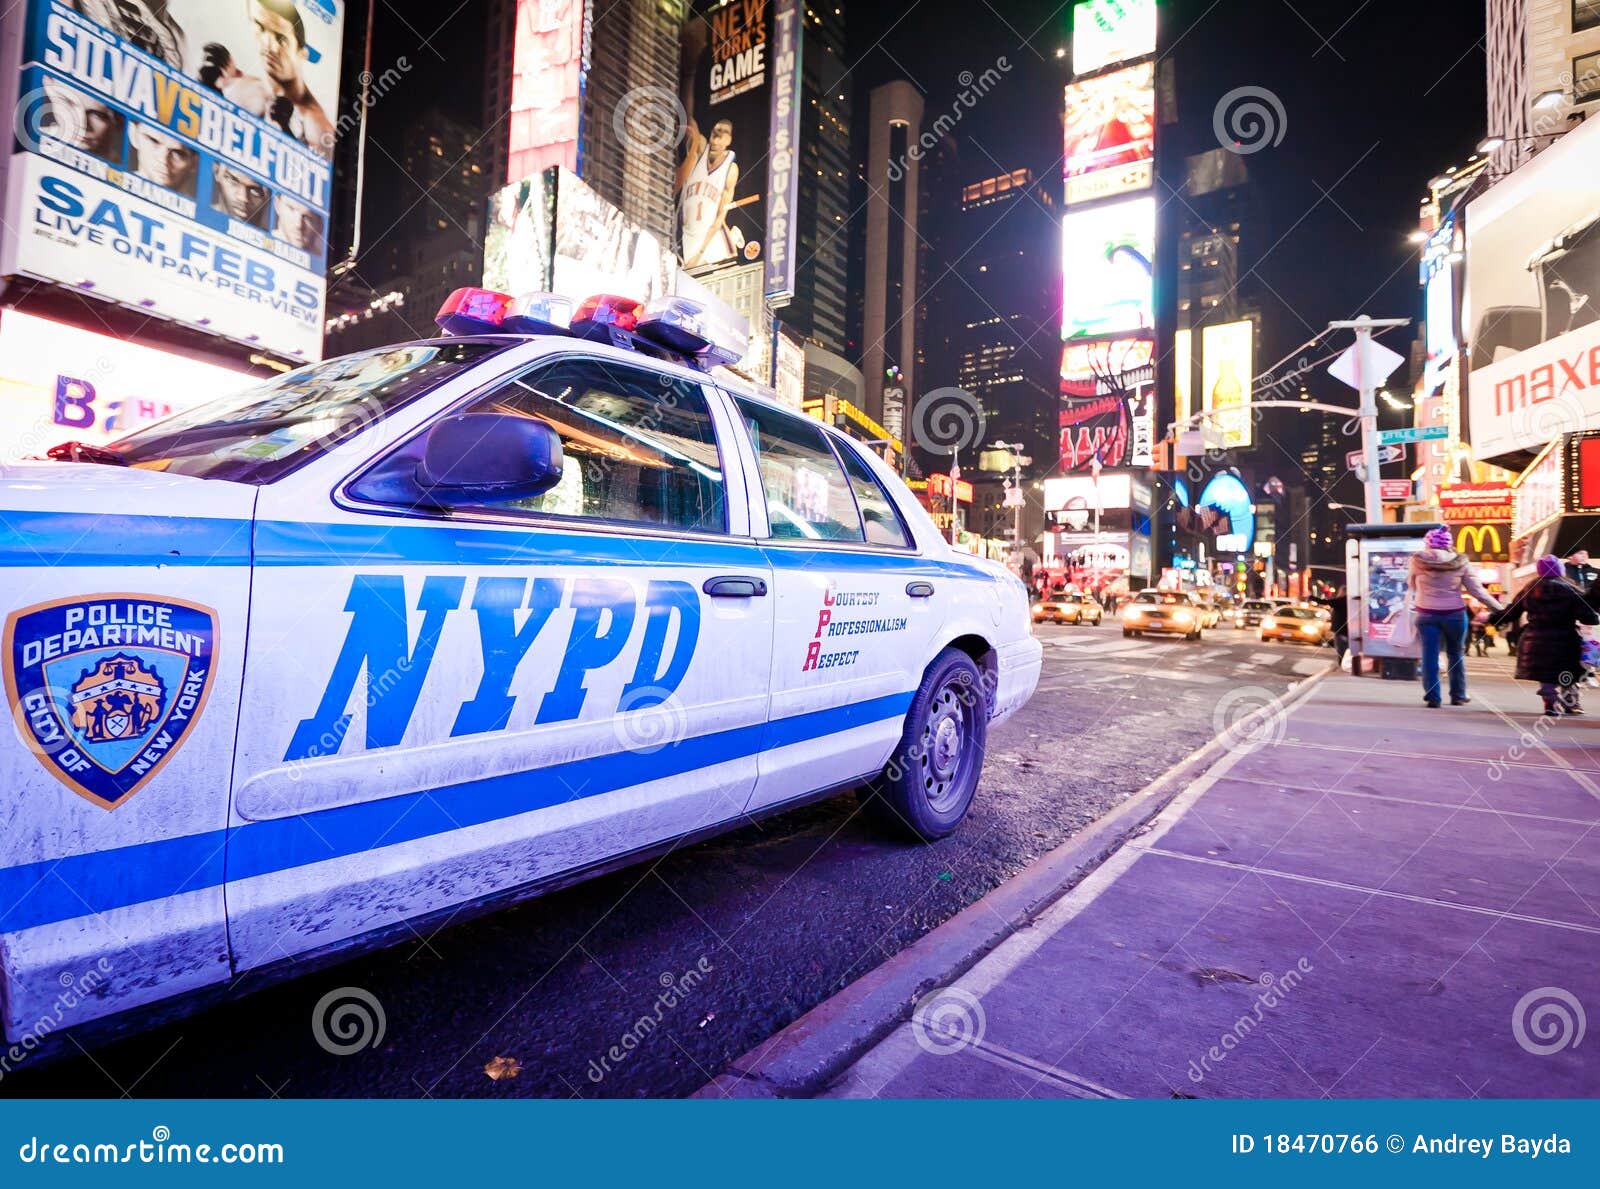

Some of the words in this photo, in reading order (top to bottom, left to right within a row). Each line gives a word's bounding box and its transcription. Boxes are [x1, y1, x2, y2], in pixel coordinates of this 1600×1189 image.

[712, 0, 766, 44] NEW
[710, 43, 766, 91] GAME
[775, 8, 795, 117] TIMES
[45, 12, 157, 119] SILVA
[154, 71, 201, 139] VS
[199, 107, 331, 207] BELFORT
[38, 175, 166, 251] SAT.
[770, 129, 794, 264] SQUARE
[35, 208, 105, 246] LIVE
[112, 238, 152, 264] ON
[161, 257, 319, 324] PAY-PER-VIEW
[22, 624, 205, 669] DEPARTMENT
[66, 603, 173, 630] POLICE
[814, 609, 908, 639] PROFESSIONALISM
[282, 574, 702, 762] NYPD
[802, 641, 860, 672] RESPECT
[24, 692, 65, 745] CITY
[57, 748, 92, 774] OF
[129, 729, 174, 776] NEW
[170, 669, 205, 722] YORK
